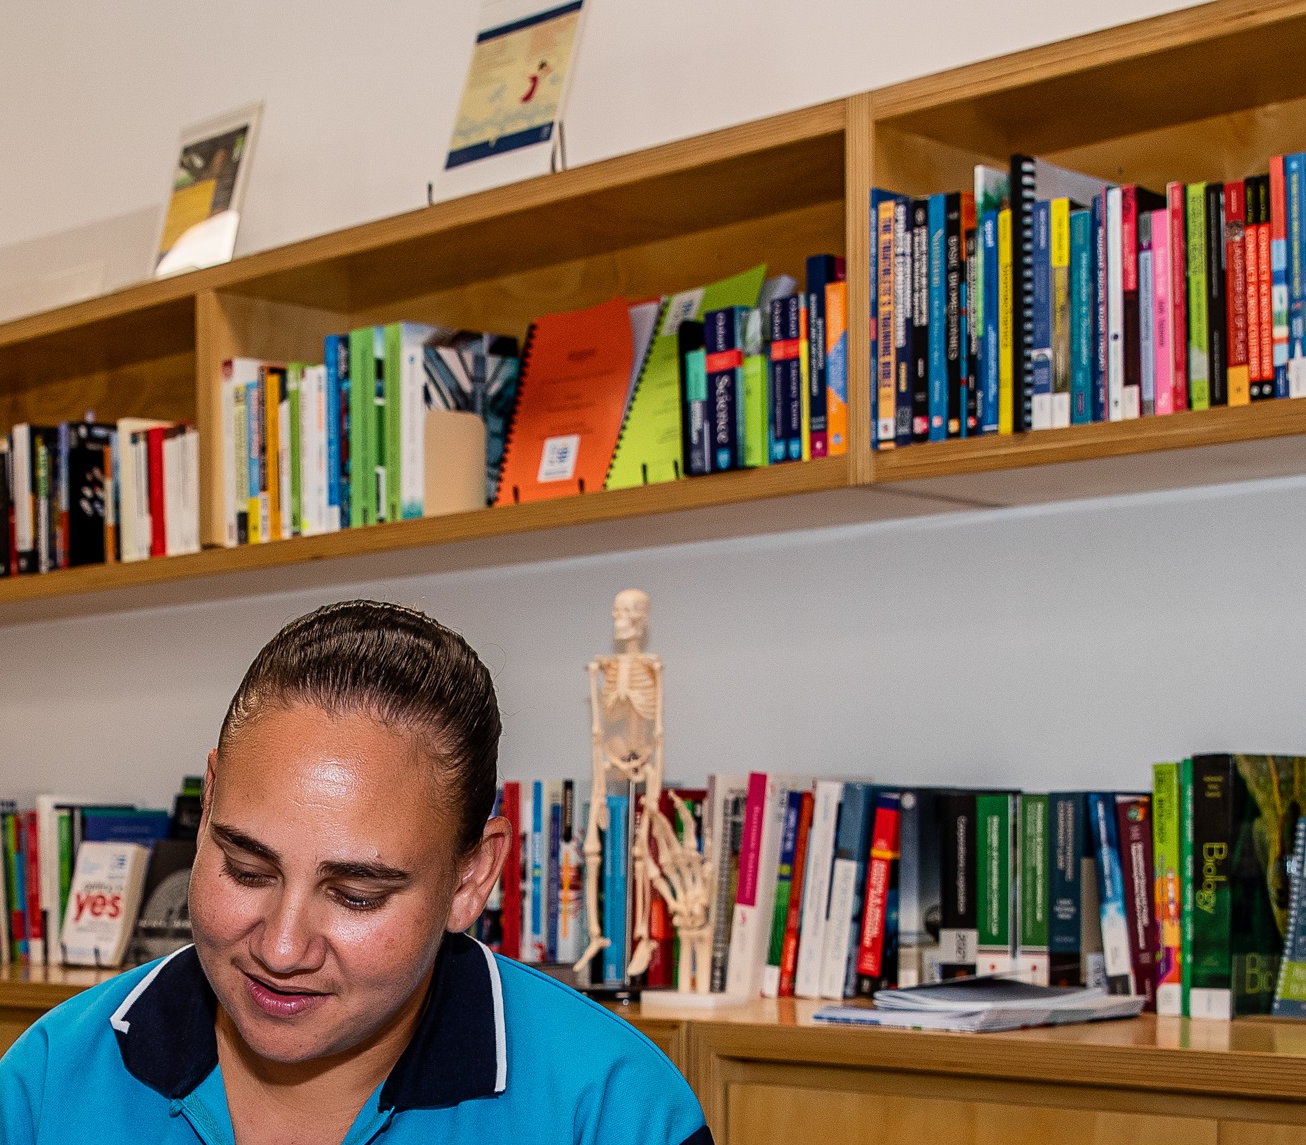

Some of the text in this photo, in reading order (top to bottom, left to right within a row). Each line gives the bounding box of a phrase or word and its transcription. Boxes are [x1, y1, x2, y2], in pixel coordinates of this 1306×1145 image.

[715, 374, 731, 444] Science
[73, 891, 122, 923] yes
[1195, 842, 1228, 915] Biology
